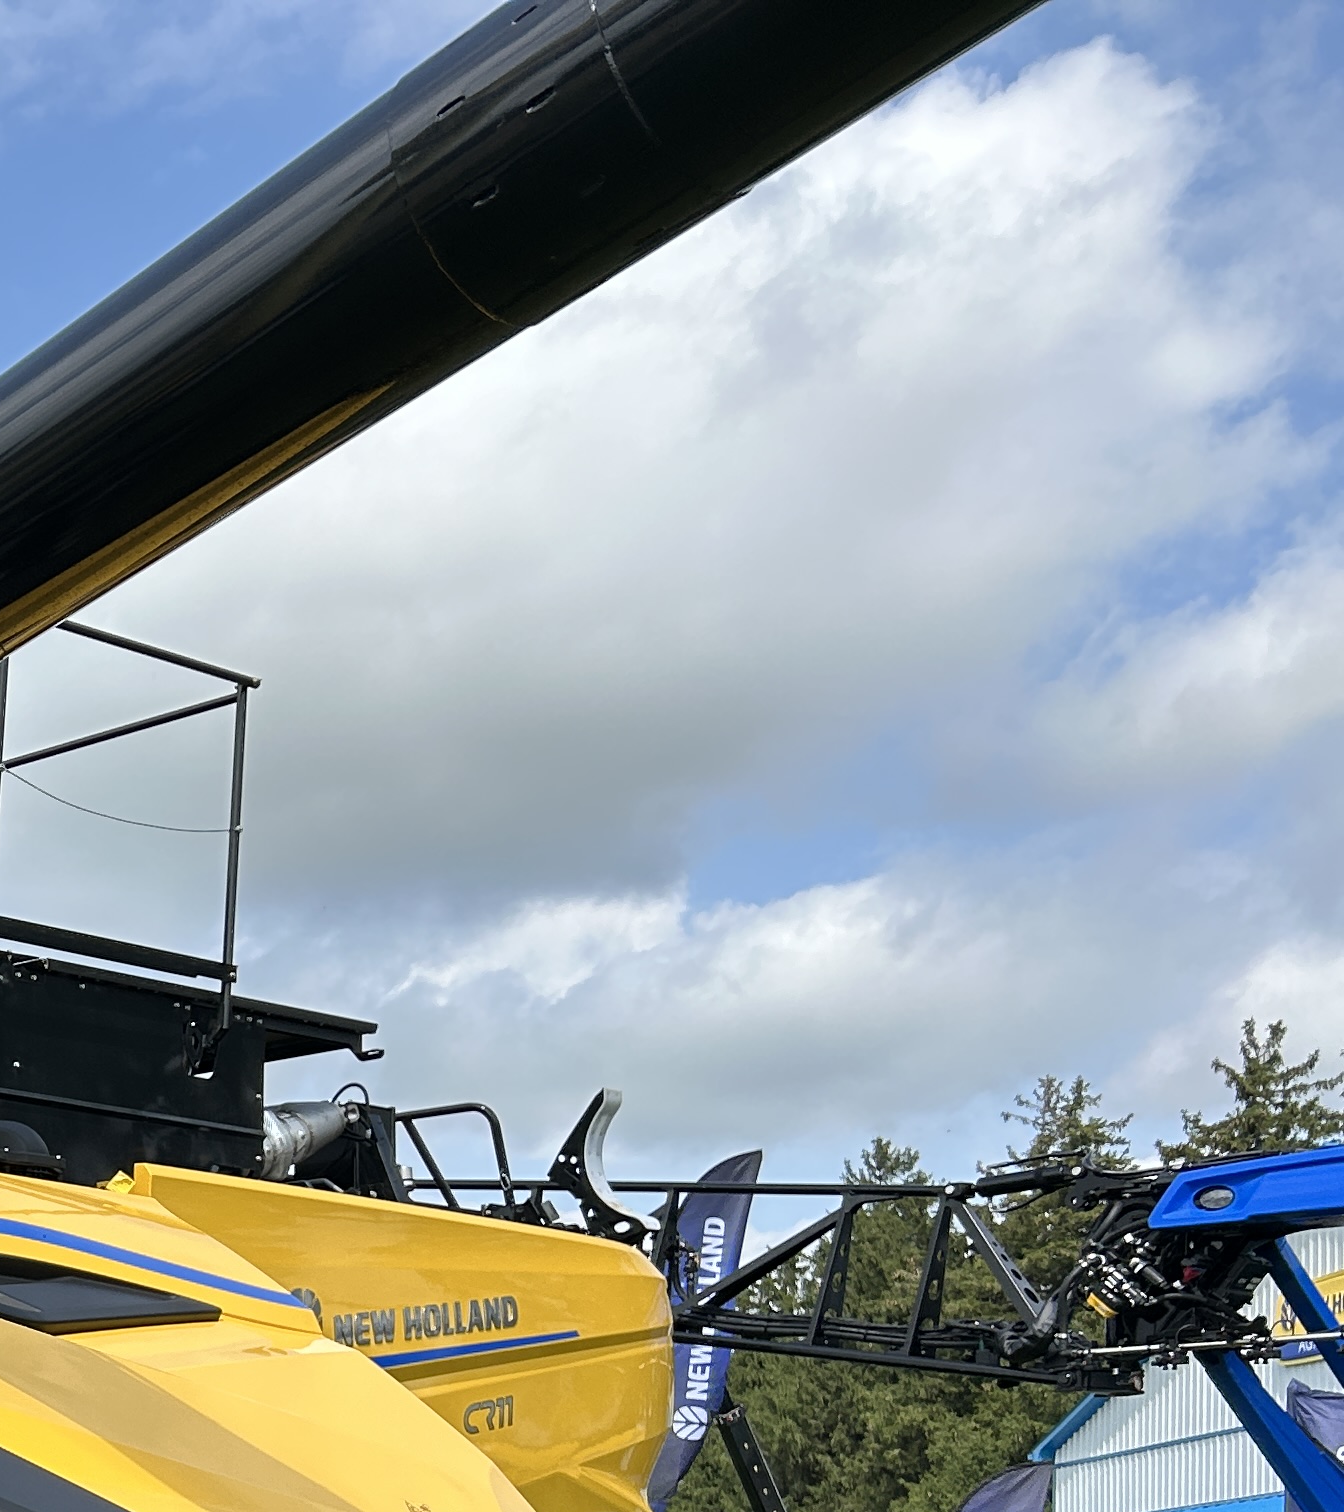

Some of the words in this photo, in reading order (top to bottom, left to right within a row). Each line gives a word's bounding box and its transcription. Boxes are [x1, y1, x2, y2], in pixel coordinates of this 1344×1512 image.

[333, 1308, 395, 1348] NEW
[403, 1295, 519, 1341] HOLLAND
[463, 1395, 514, 1435] CR11
